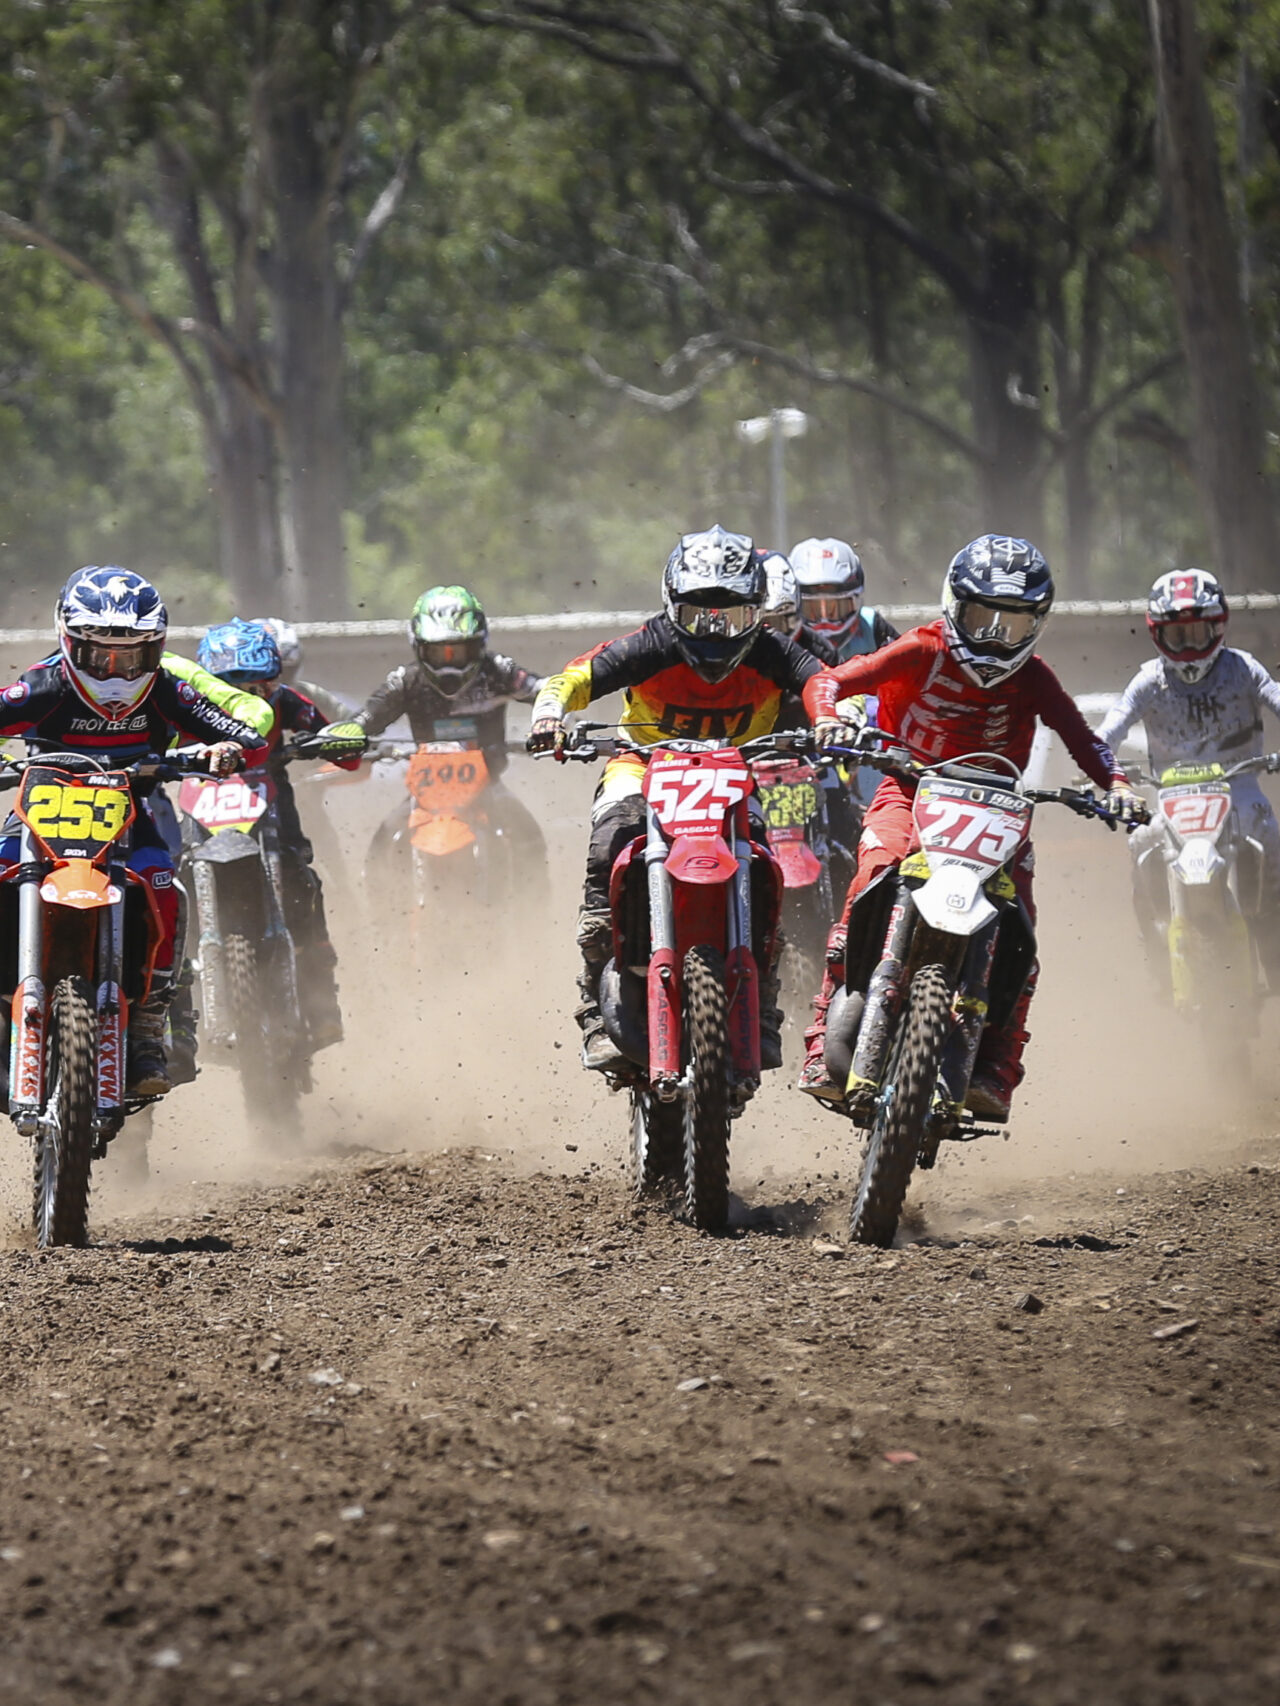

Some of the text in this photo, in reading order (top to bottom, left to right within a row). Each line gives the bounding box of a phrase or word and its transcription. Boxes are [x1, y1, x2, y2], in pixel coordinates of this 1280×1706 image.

[70, 718, 106, 731] TROY
[27, 784, 130, 842] 253
[192, 783, 268, 823] 420
[647, 768, 749, 824] 525
[674, 825, 718, 835] GASGAS
[920, 800, 1021, 861] 275
[99, 1014, 118, 1102] MAXXIS
